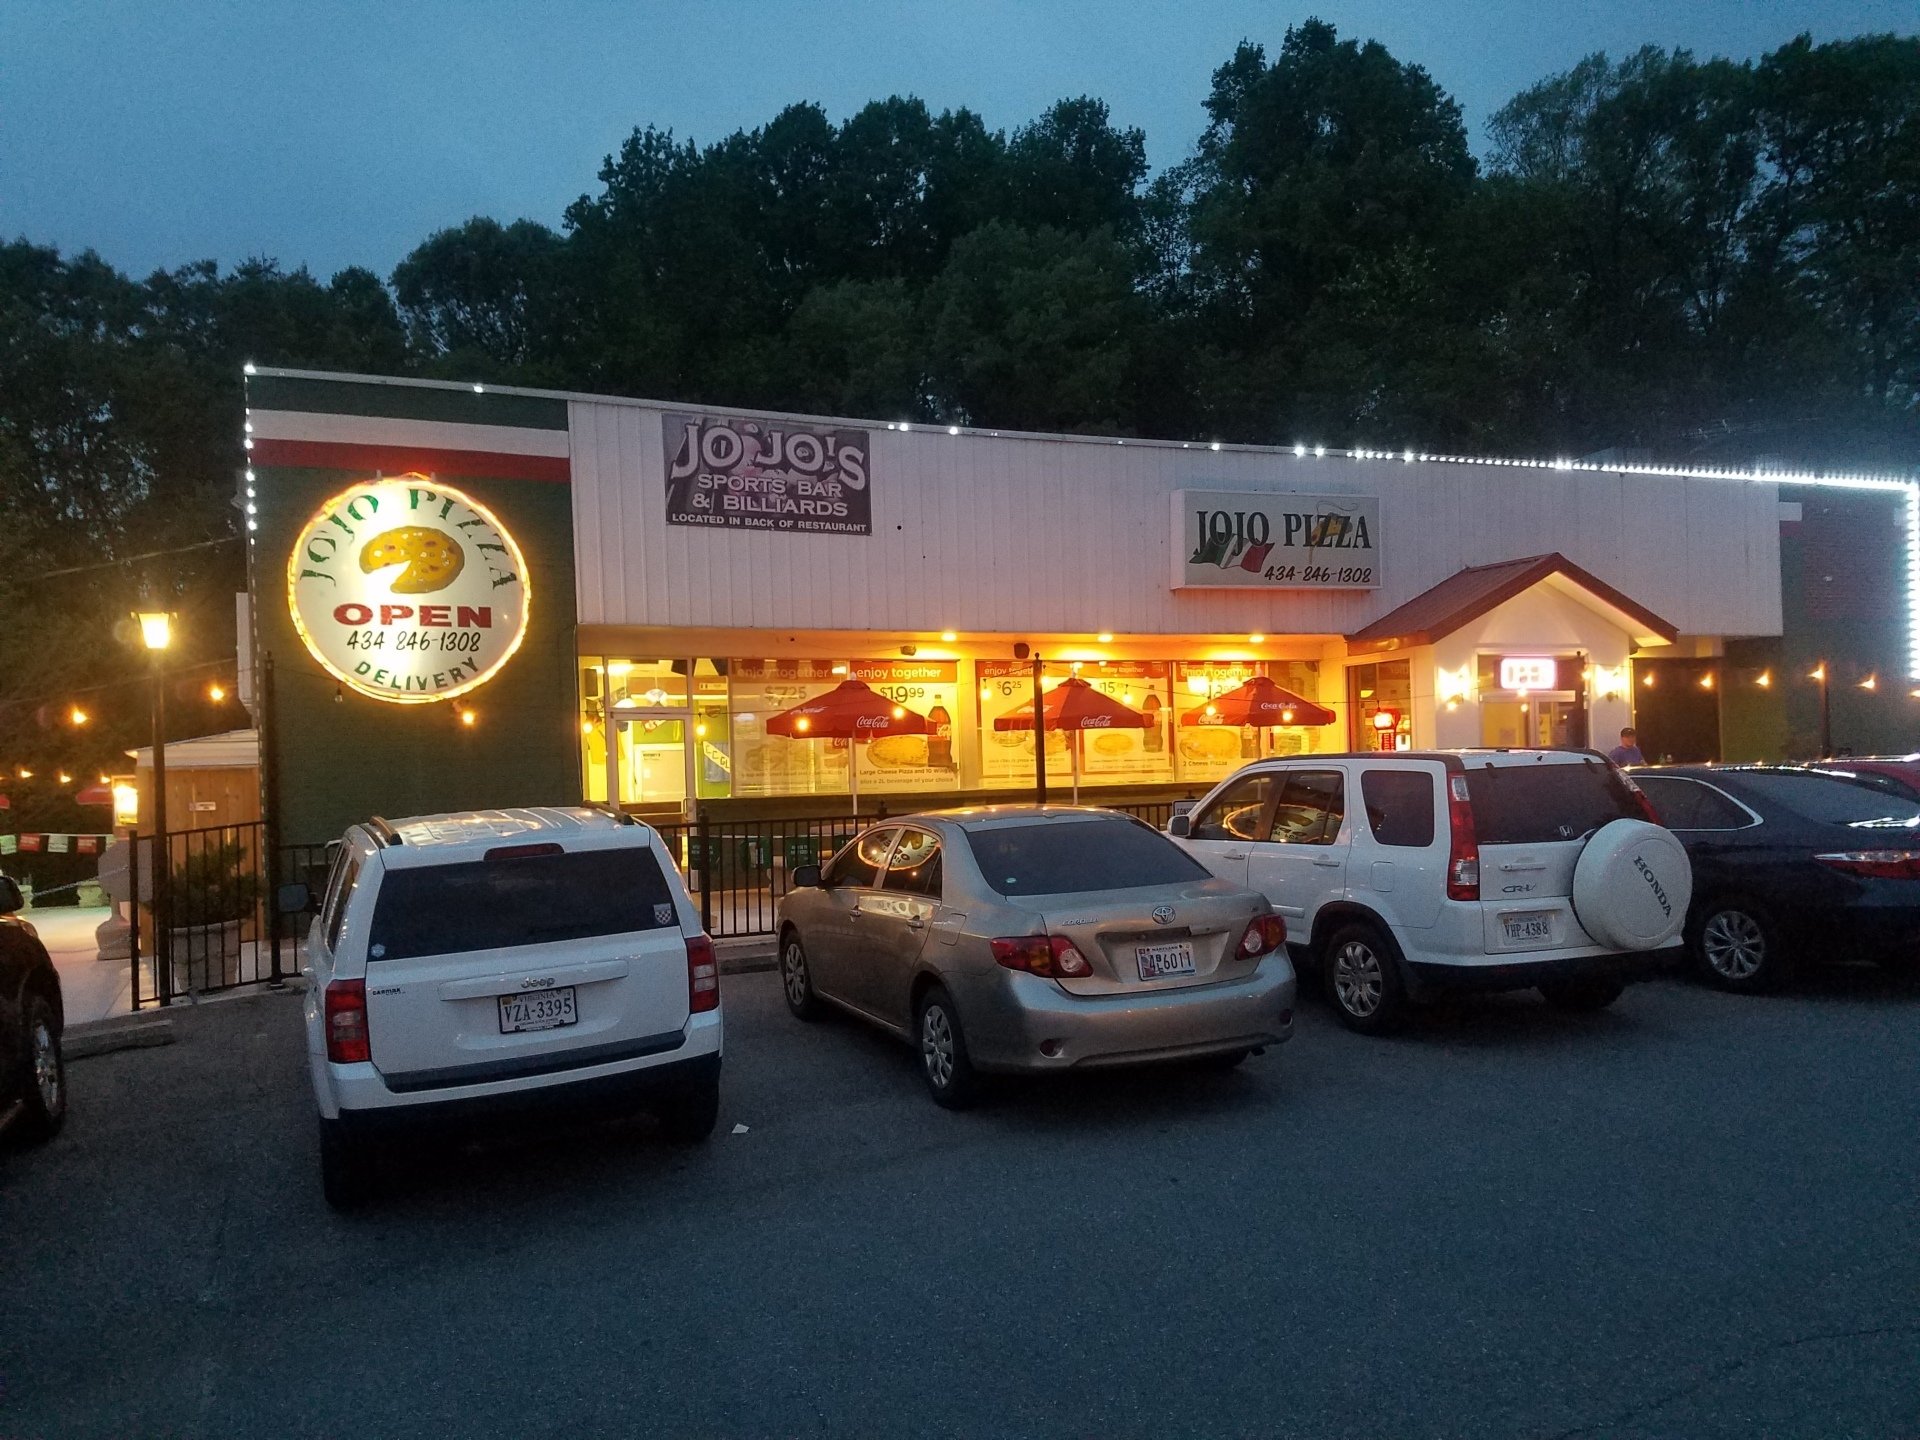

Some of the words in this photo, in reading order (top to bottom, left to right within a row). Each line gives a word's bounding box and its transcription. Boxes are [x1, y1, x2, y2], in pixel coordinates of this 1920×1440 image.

[698, 473, 786, 494] SPORTS
[797, 480, 842, 498] BAR
[692, 493, 710, 508] &
[723, 495, 849, 517] BILLIARDS
[672, 513, 725, 525] LOCATED
[729, 516, 741, 526] IN
[744, 517, 774, 527] BACK
[779, 519, 794, 529] OF
[797, 521, 867, 533] RESTAURANT
[1193, 510, 1270, 557] JOJO
[1283, 512, 1372, 549] PIZZA
[408, 488, 517, 590] PIZZA
[1264, 565, 1372, 583] 434-846-1308
[333, 602, 492, 629] OPEN
[347, 631, 385, 650] 434
[396, 631, 481, 652] 846-1308
[354, 656, 480, 691] DELIVERY
[856, 667, 888, 680] enjoy
[892, 667, 941, 679] together
[1633, 855, 1672, 919] HONDA
[521, 977, 556, 988] Jeep
[504, 997, 572, 1022] VZA-3395
